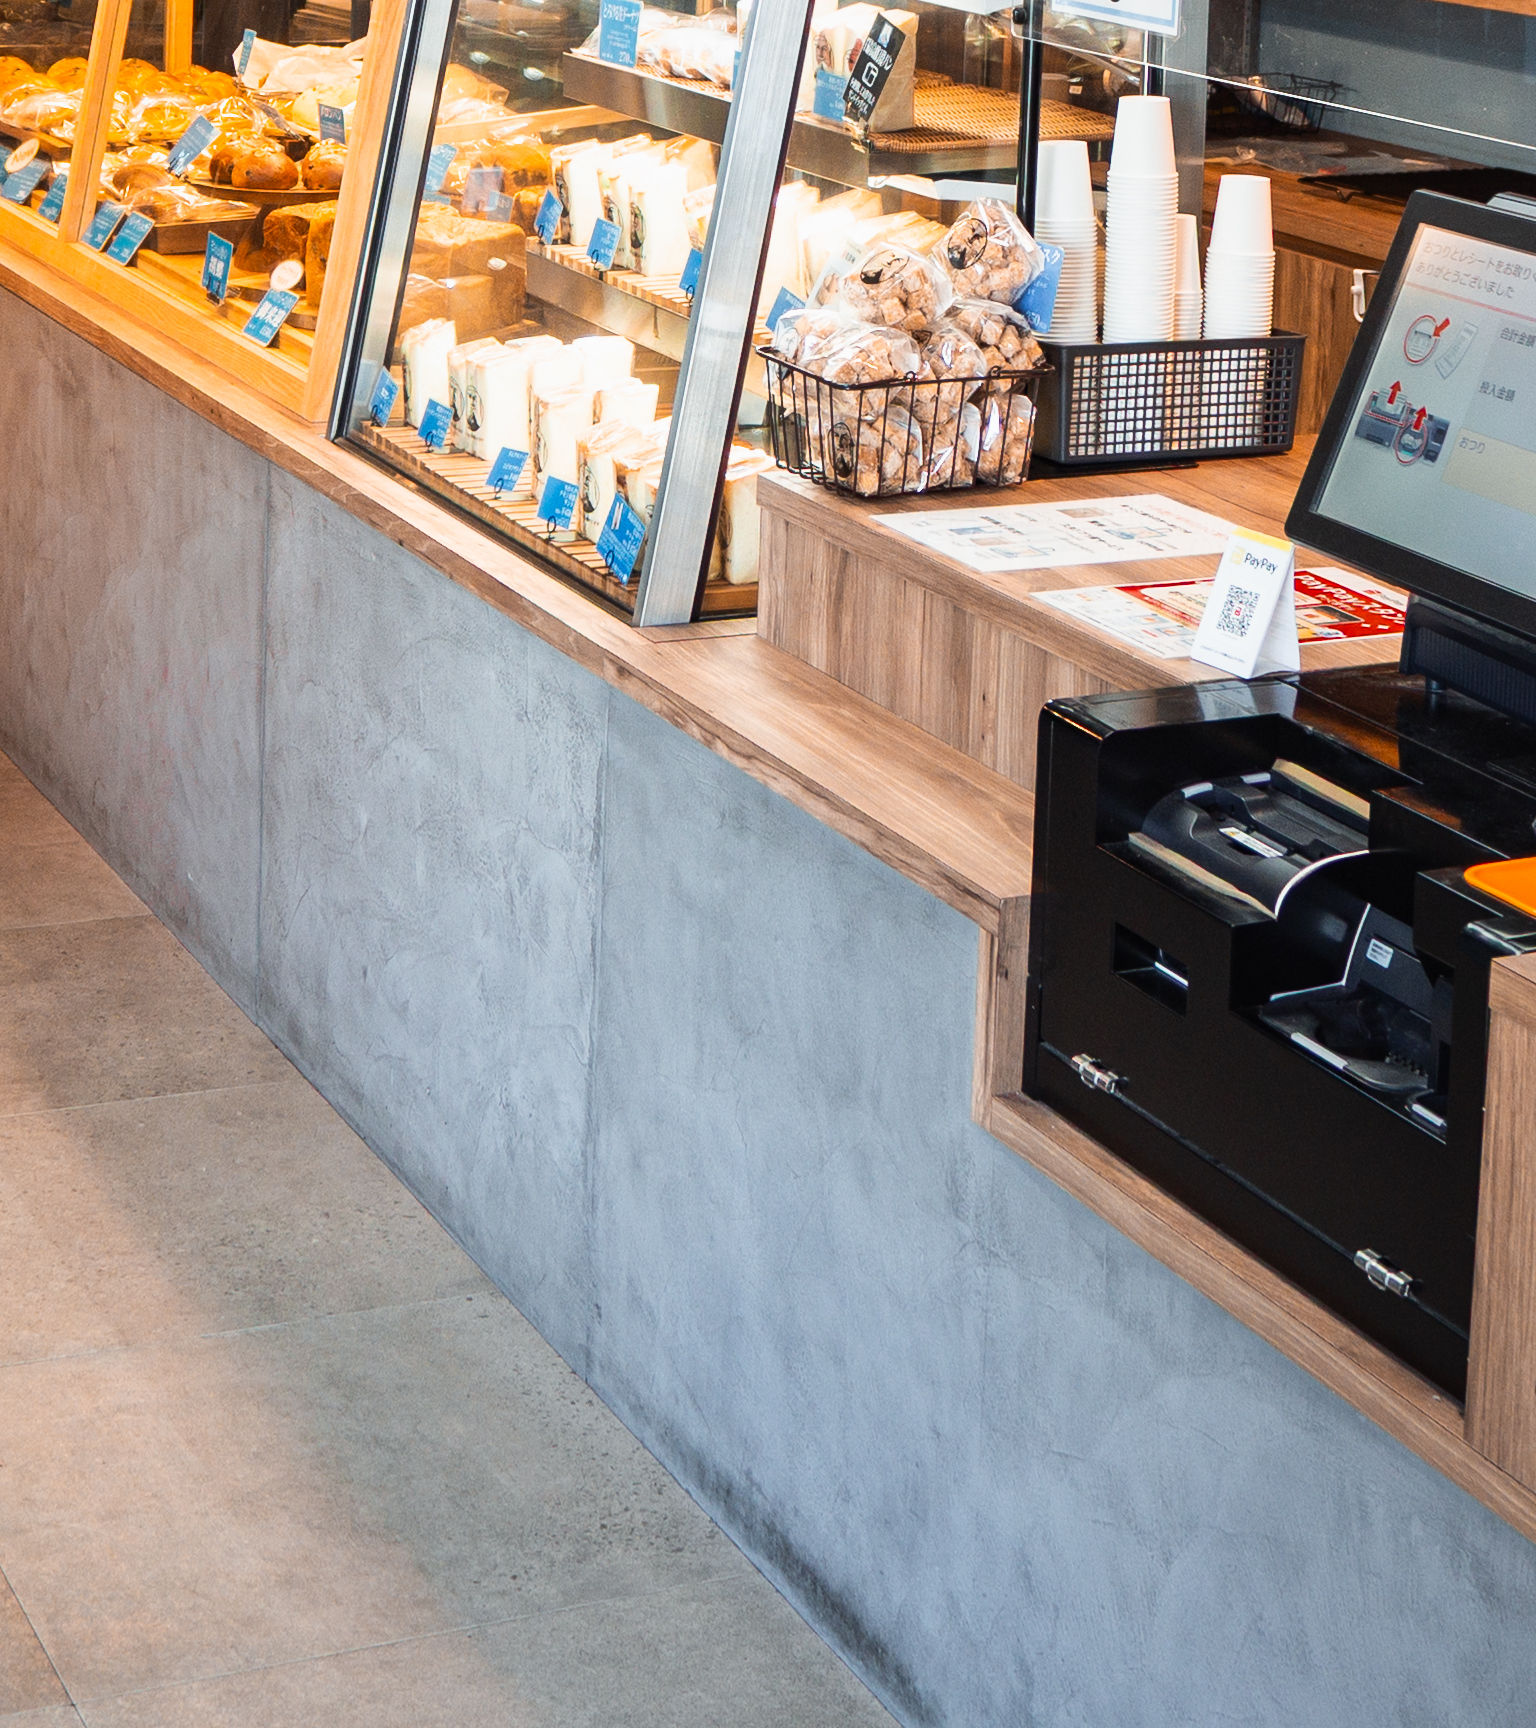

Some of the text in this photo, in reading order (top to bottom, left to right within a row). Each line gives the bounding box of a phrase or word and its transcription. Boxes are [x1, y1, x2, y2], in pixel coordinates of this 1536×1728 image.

[1415, 262, 1515, 299] ありがとうございました
[1478, 380, 1516, 403] 投入金額
[1458, 435, 1487, 454] おつり
[1243, 552, 1279, 575] PayPay
